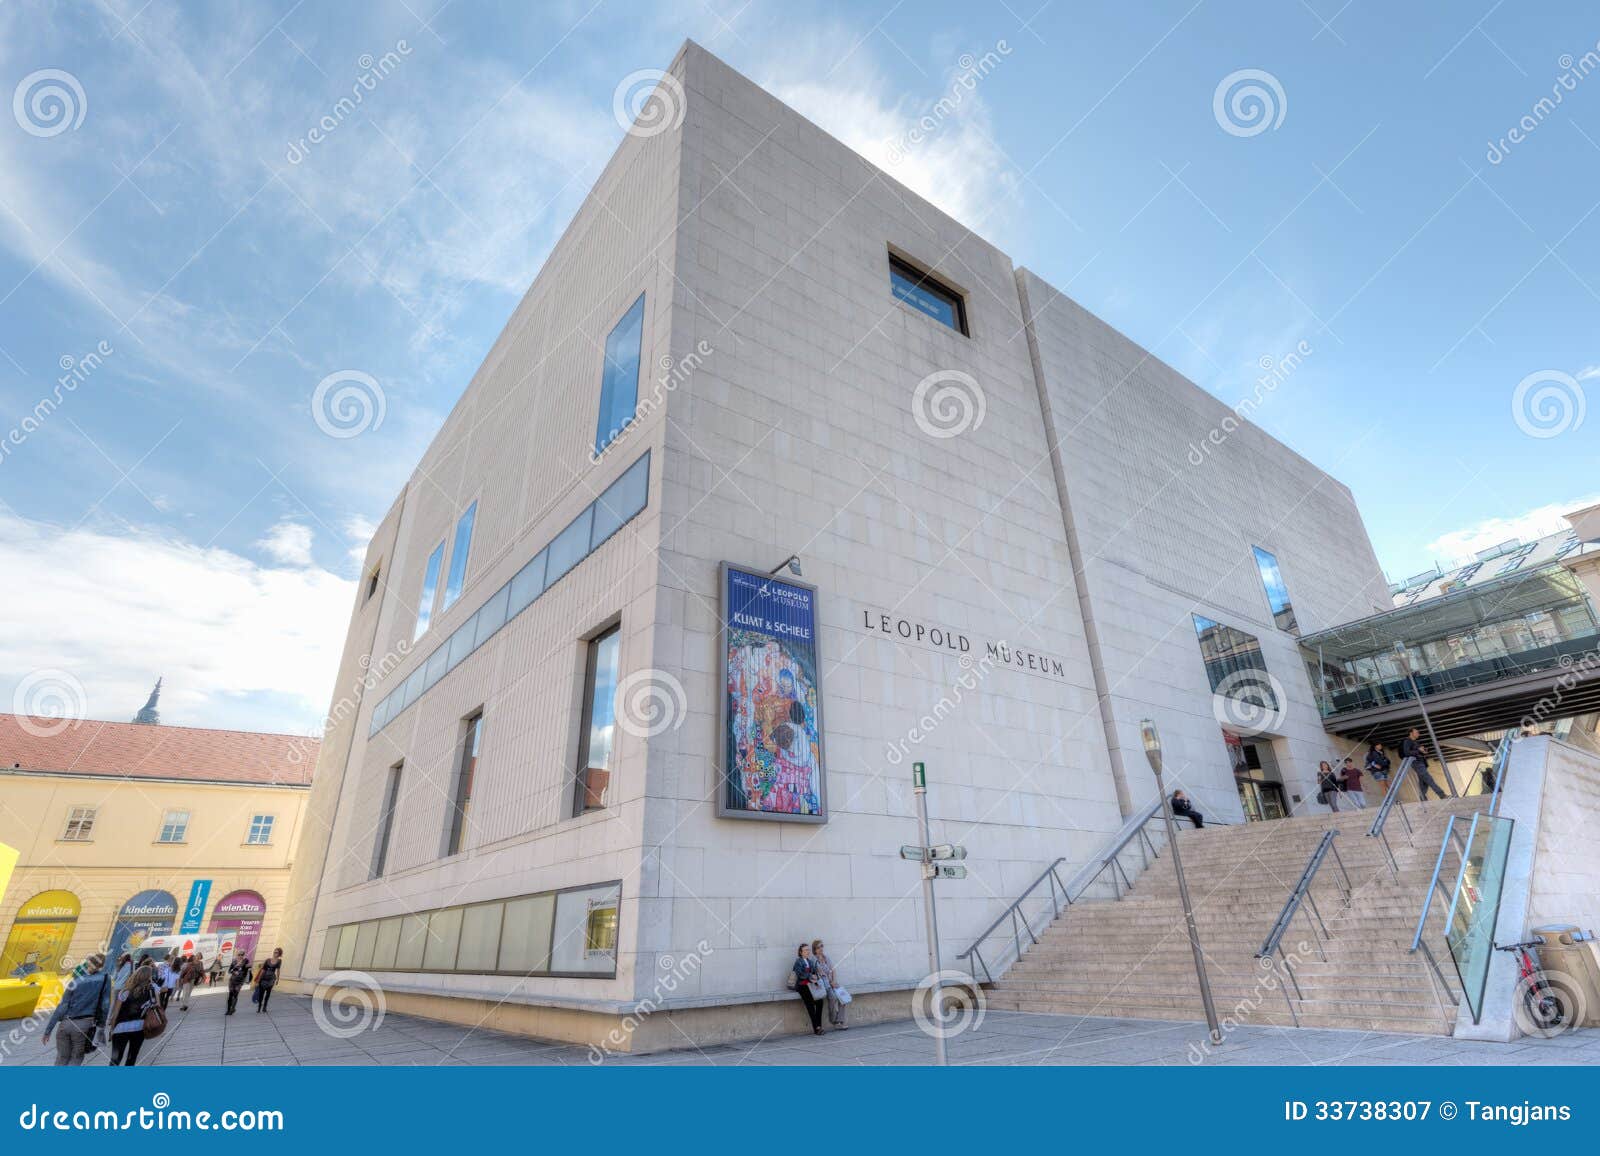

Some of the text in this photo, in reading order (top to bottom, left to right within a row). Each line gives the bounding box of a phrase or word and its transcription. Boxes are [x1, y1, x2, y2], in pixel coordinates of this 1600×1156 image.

[772, 587, 809, 602] LEOPOLD
[773, 596, 809, 610] MUSEUM
[734, 612, 764, 628] KLIMT
[774, 621, 811, 639] SCHIELE
[864, 610, 1064, 676] LEOPOLD MUSEUM
[27, 906, 72, 916] wienXtra
[125, 904, 174, 914] kinderinfo
[221, 903, 260, 912] wienXtra
